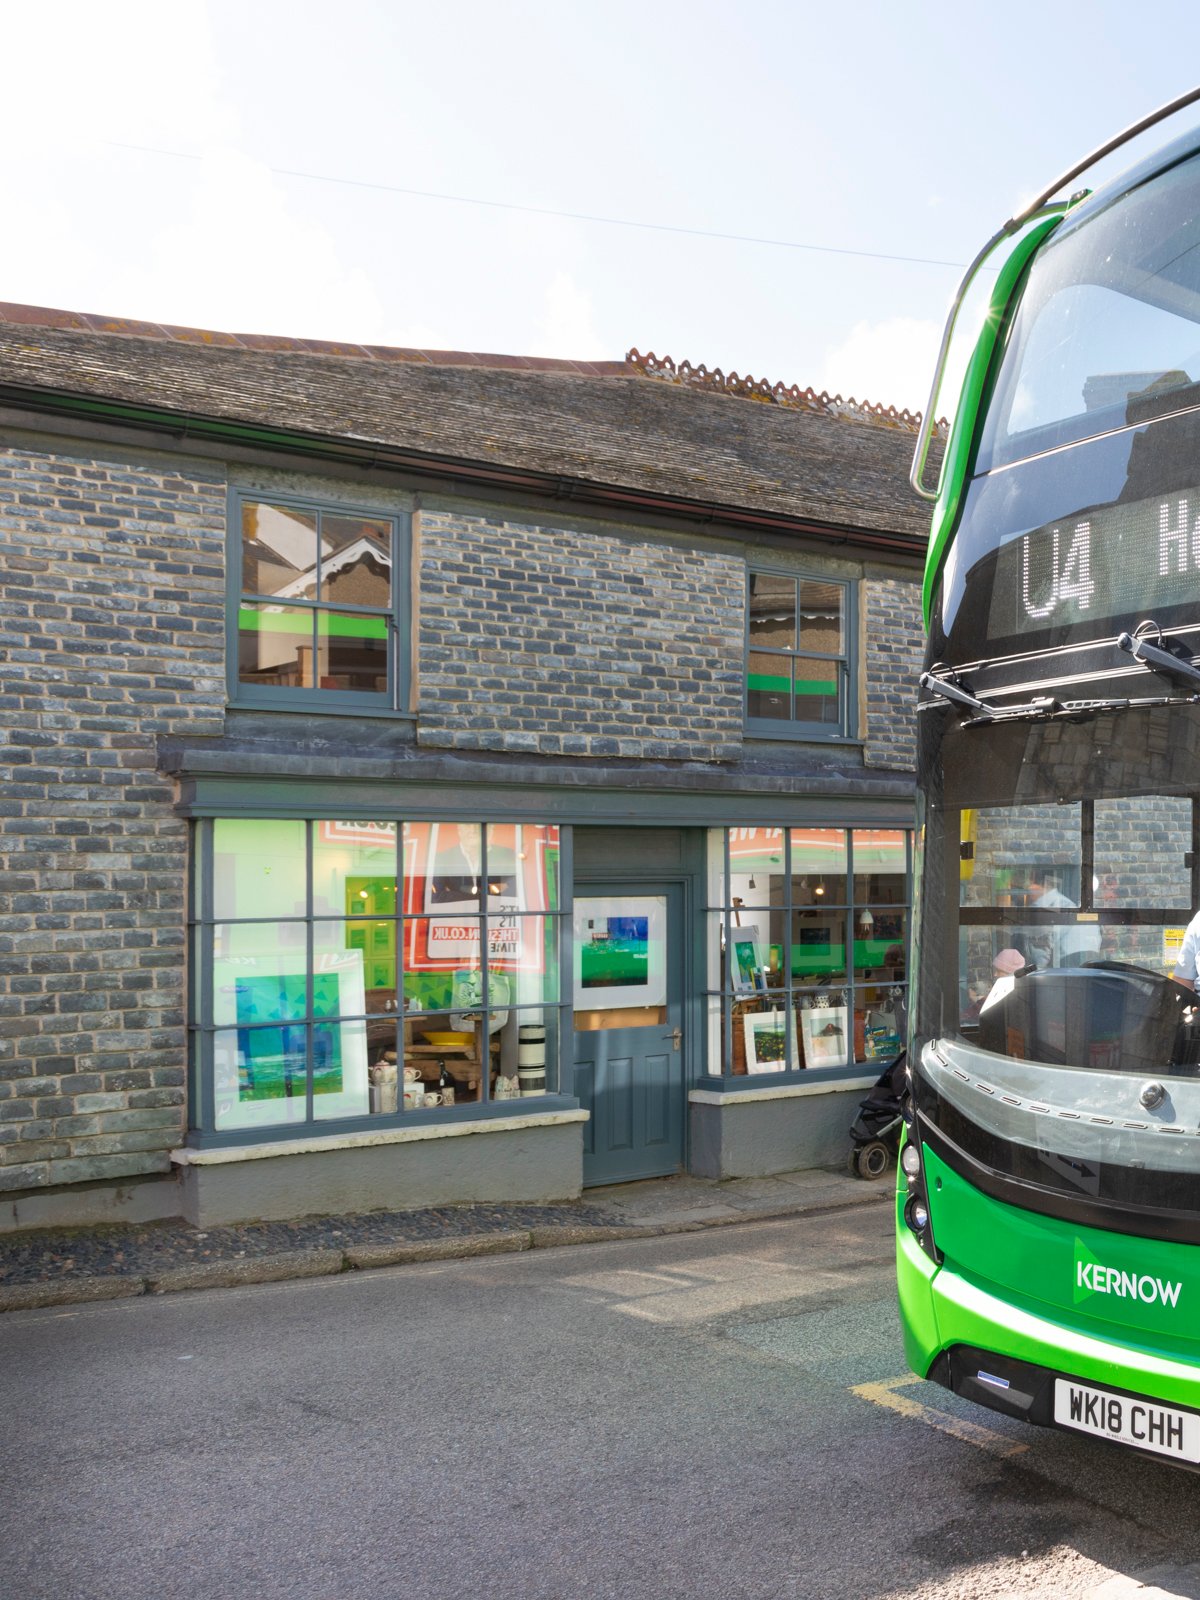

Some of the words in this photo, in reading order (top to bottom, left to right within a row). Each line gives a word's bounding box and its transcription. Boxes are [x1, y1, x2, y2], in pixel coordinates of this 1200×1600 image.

[1022, 521, 1095, 618] U4
[1077, 1261, 1182, 1308] KERNOW
[1070, 1387, 1123, 1434] WK18
[1130, 1405, 1183, 1451] CHH
